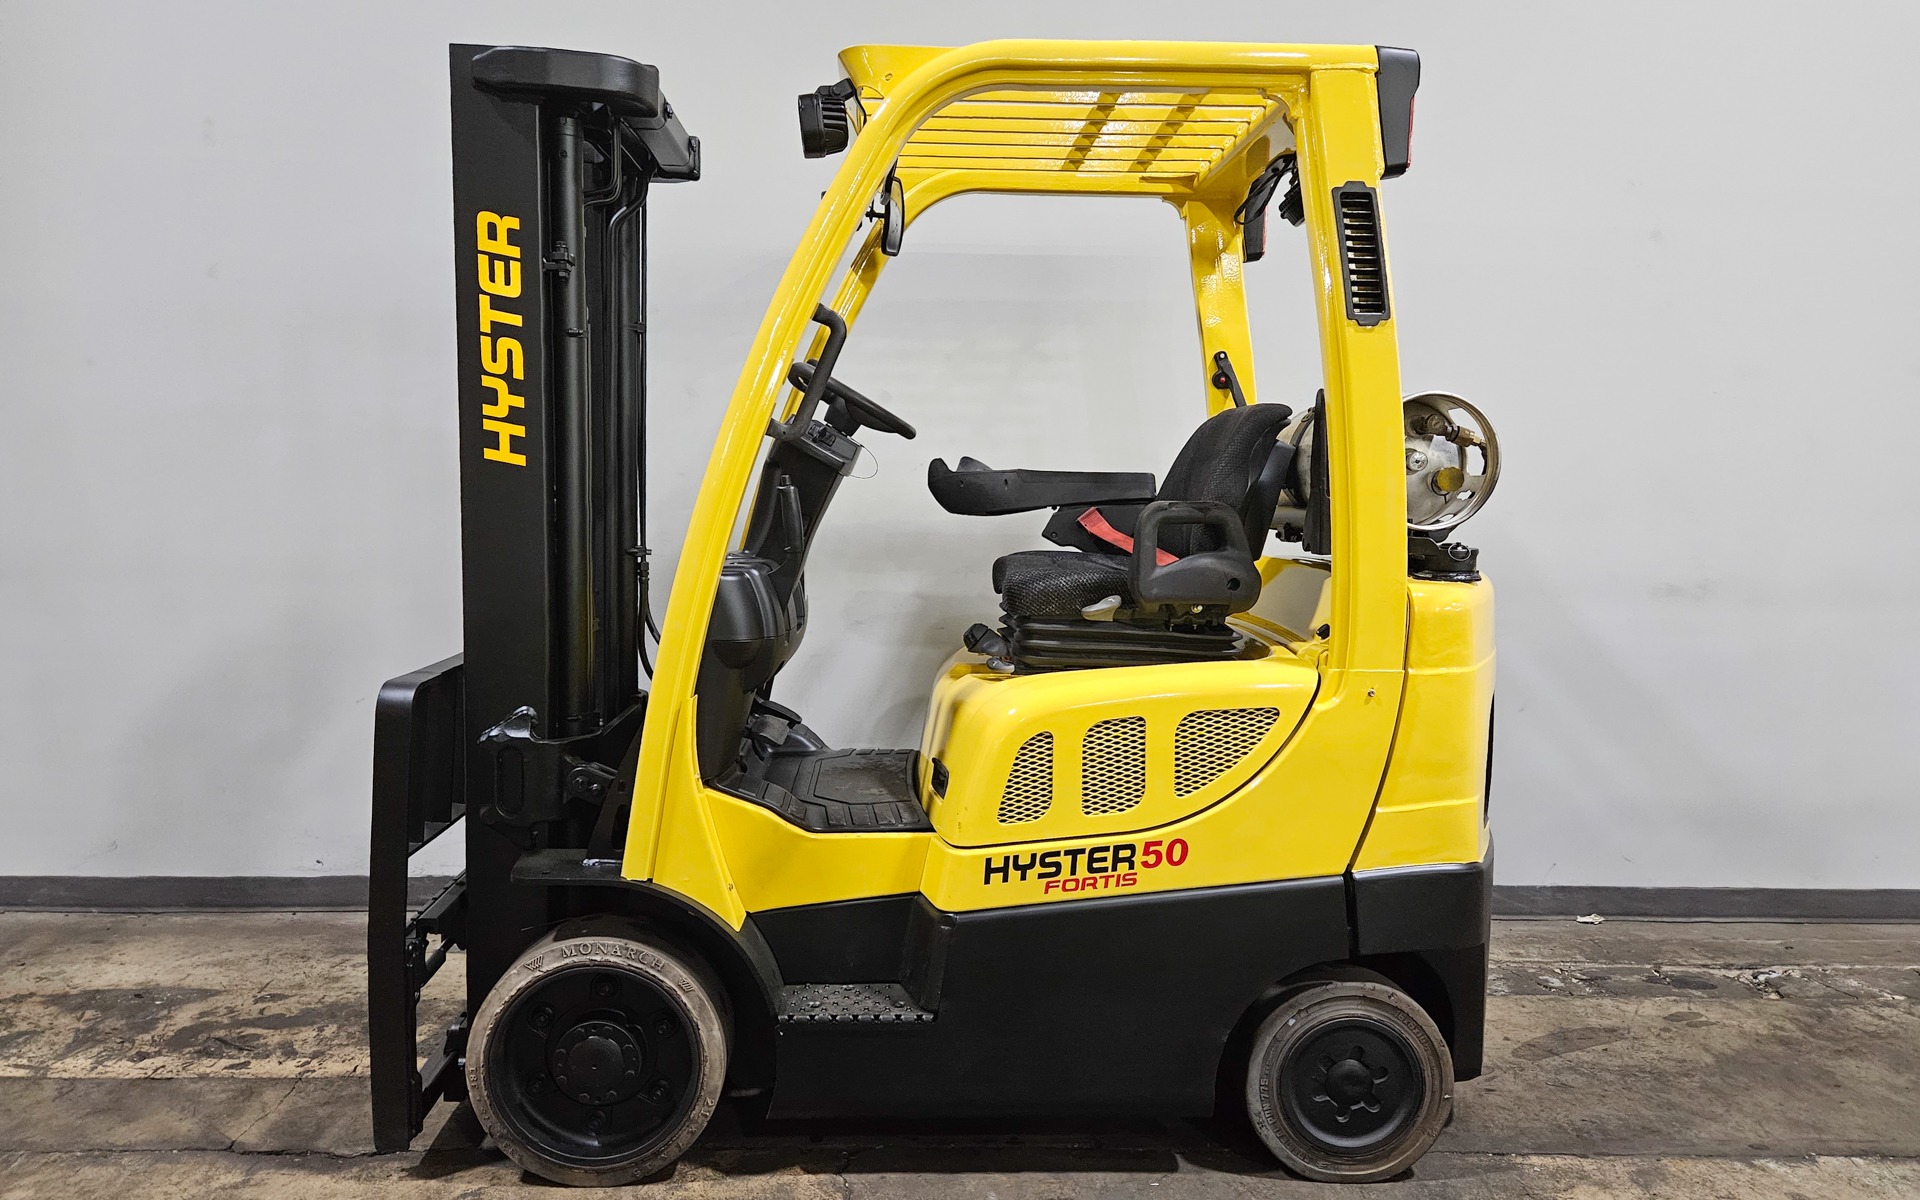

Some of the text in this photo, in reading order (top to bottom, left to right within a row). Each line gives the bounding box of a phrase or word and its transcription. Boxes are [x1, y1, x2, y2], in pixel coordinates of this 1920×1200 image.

[476, 210, 527, 467] HYSTER
[983, 838, 1189, 885] HYSTER 50
[1044, 872, 1138, 895] FORTIS
[561, 942, 665, 971] MONARCH
